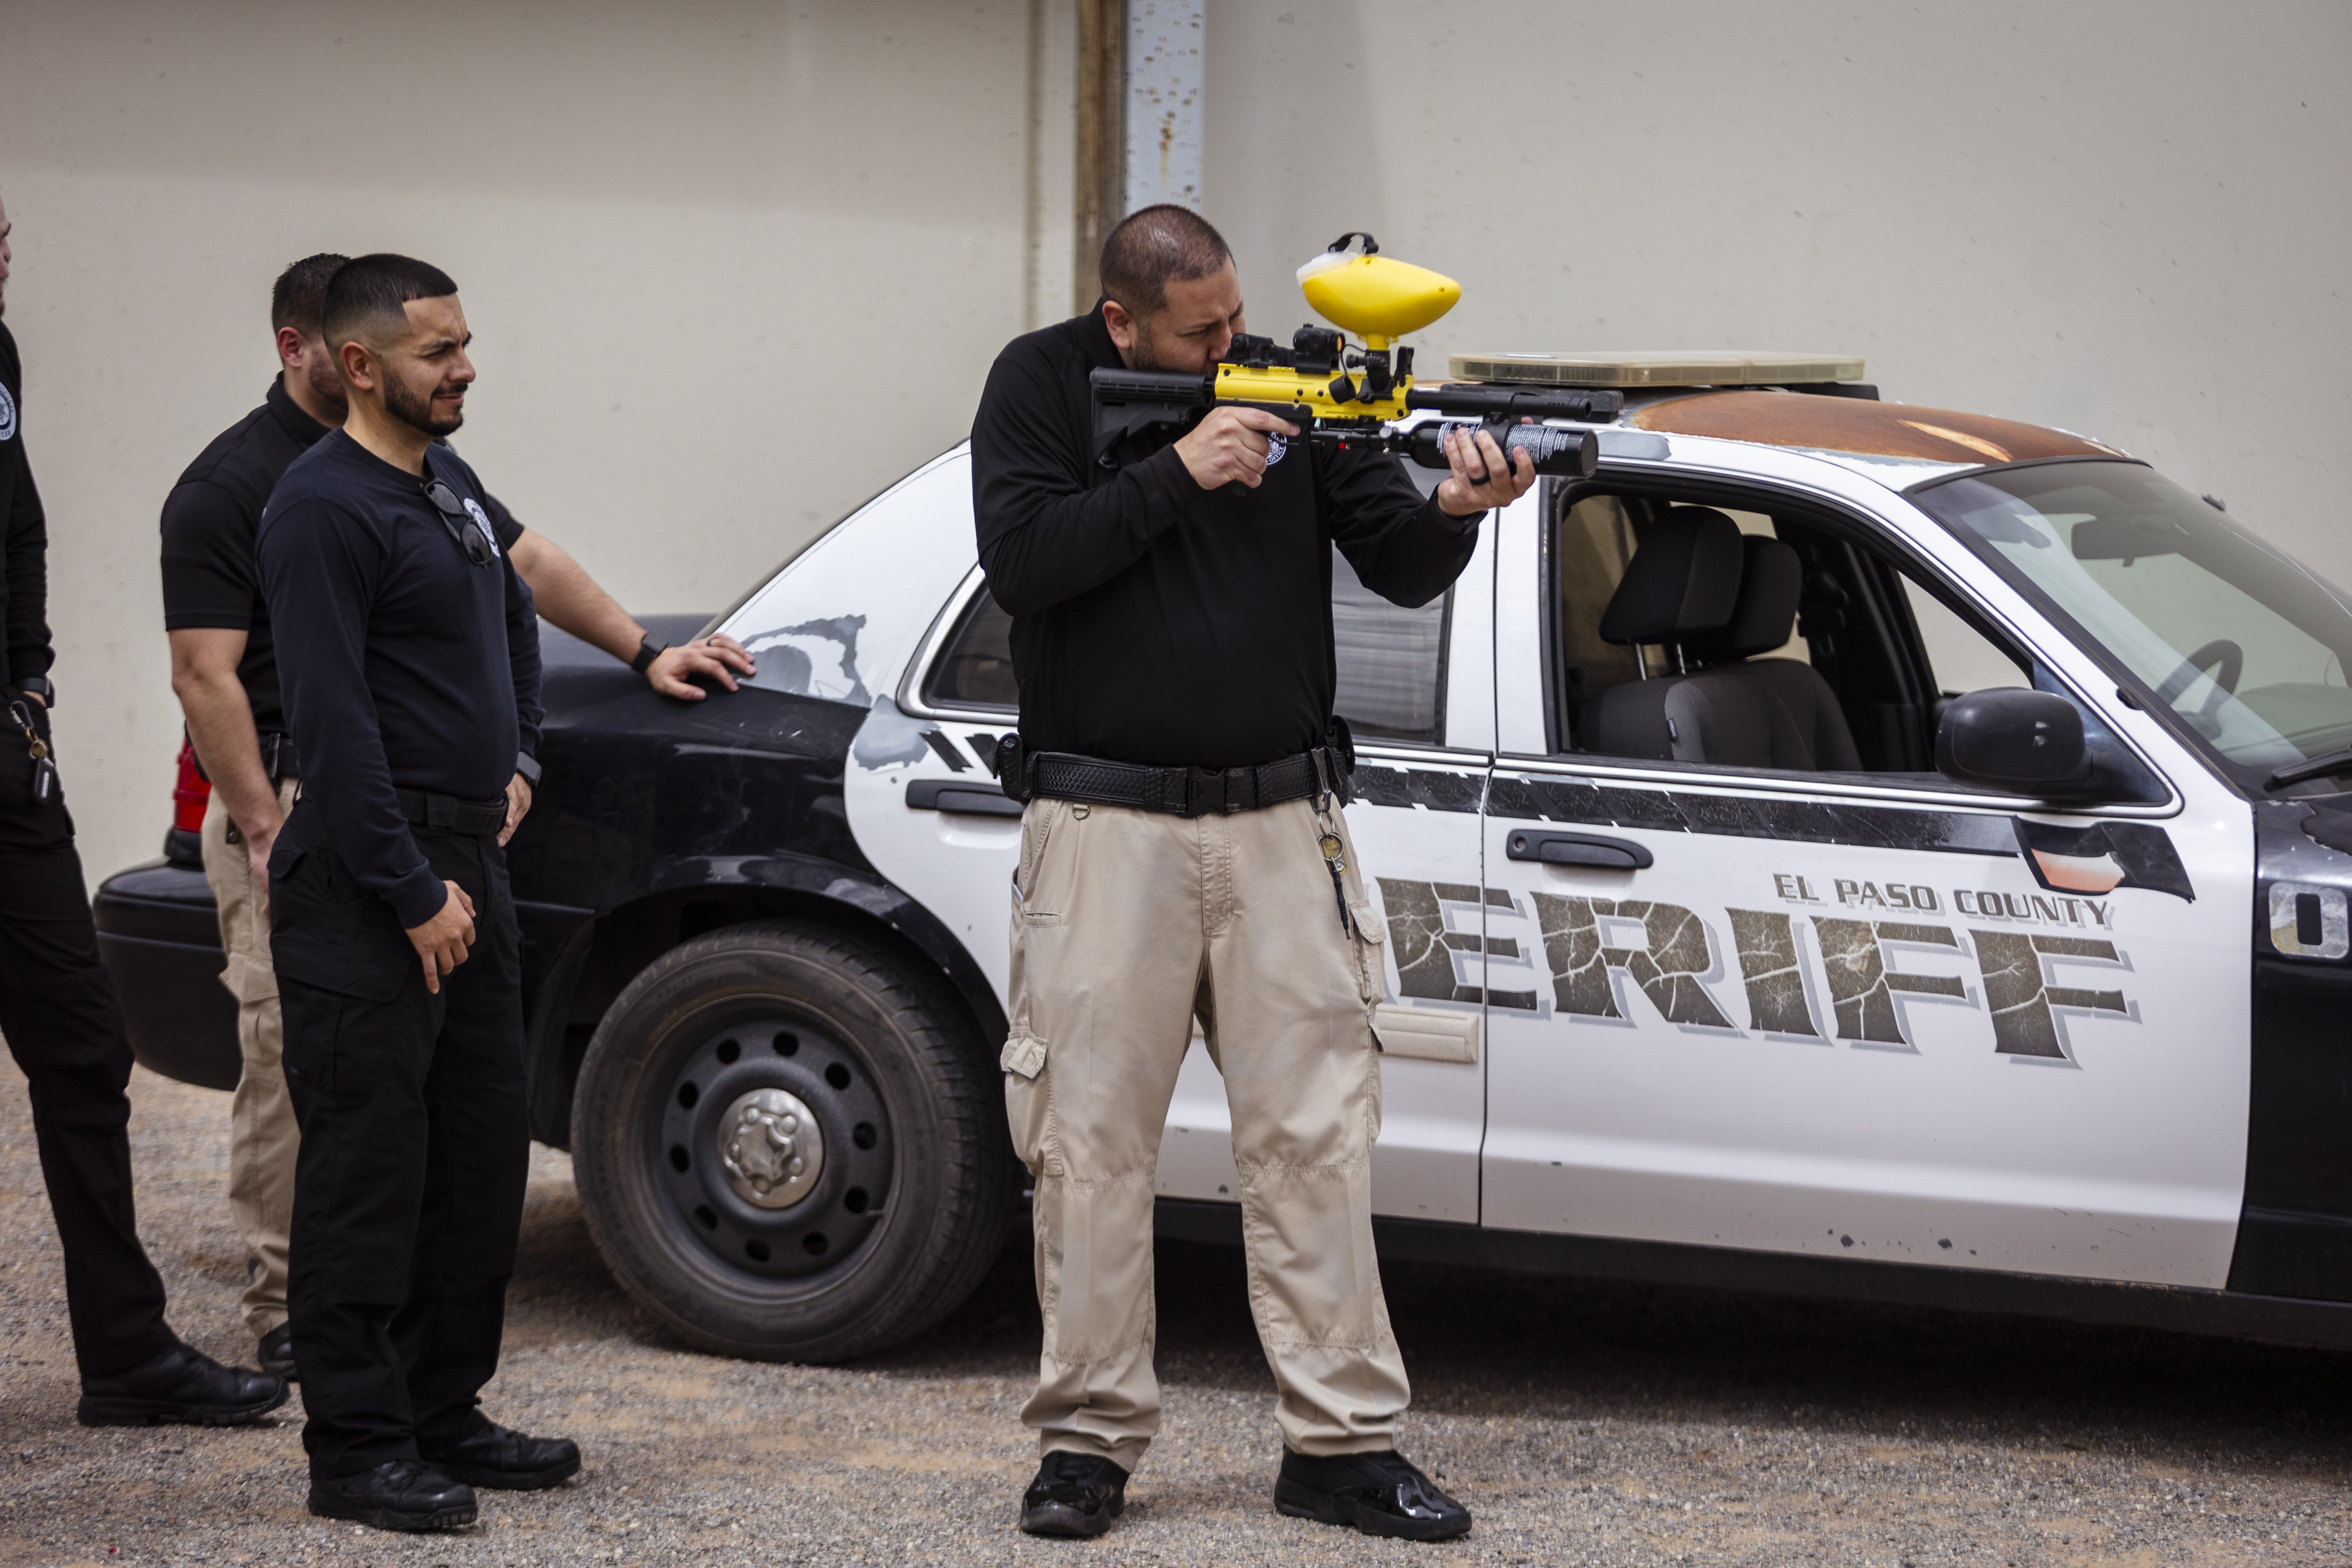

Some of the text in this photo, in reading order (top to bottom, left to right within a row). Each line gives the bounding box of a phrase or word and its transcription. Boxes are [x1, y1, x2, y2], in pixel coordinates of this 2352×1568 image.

[1269, 445, 1284, 463] OFFICE
[1773, 873, 2109, 926] EL PASO COUNTY
[1374, 876, 2132, 1064] ERIFF
